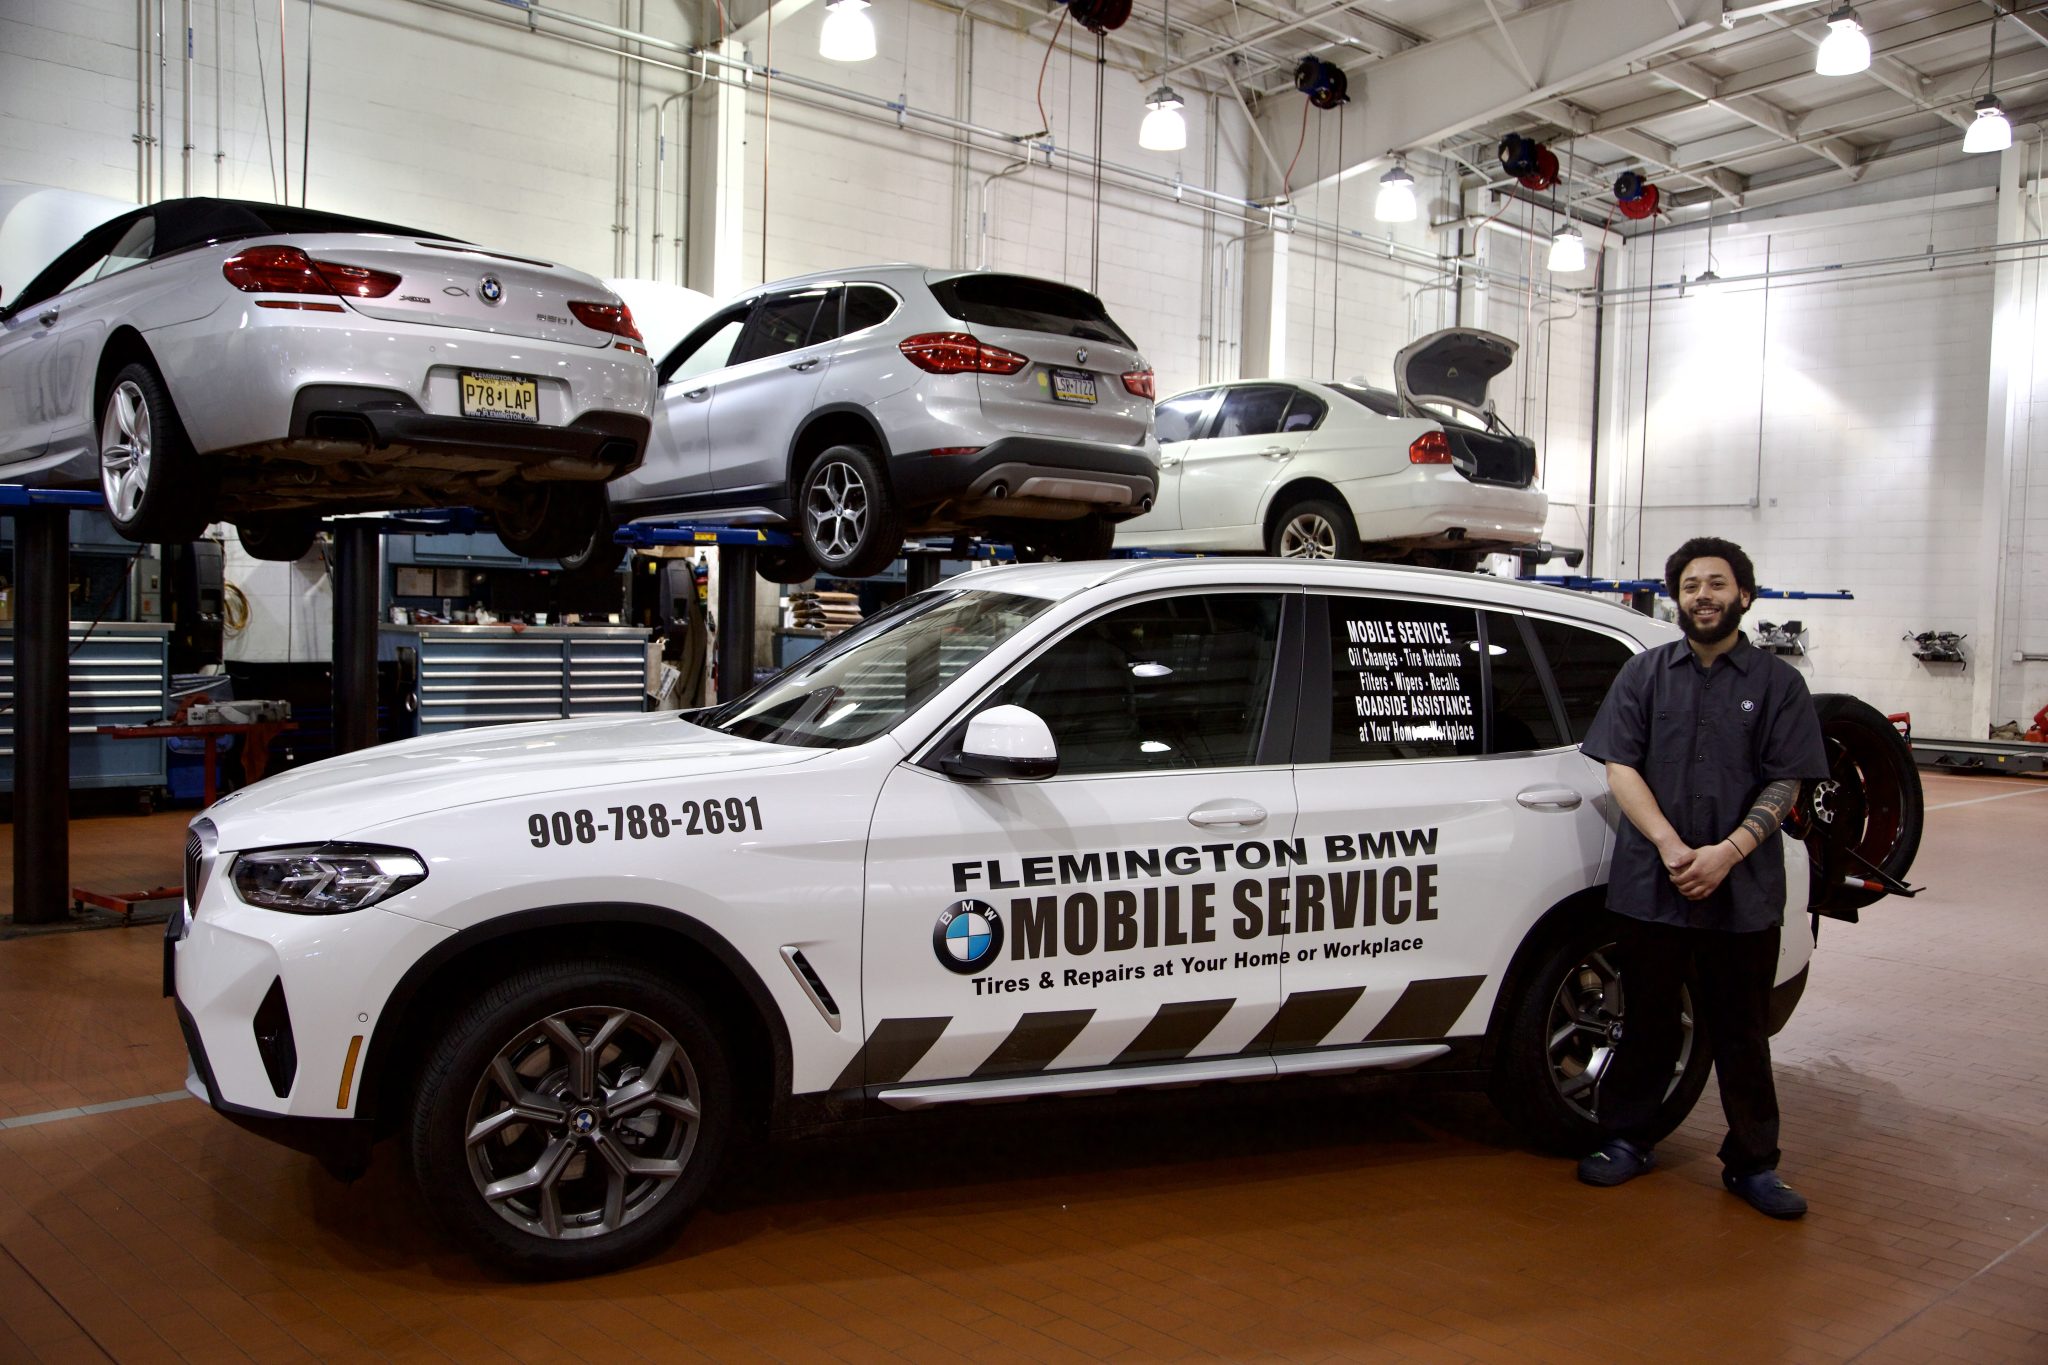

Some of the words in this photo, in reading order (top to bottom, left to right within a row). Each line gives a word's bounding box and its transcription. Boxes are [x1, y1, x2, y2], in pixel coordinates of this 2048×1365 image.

[466, 384, 494, 406] P78
[504, 388, 532, 410] LAP
[1346, 621, 1397, 643] MOBILE
[1397, 621, 1451, 644] SERVICE
[1348, 647, 1361, 667] Oil
[1362, 648, 1398, 671] Changes
[1403, 648, 1421, 667] Tire
[1422, 648, 1461, 667] Rotations
[1359, 672, 1389, 691] Filters
[1394, 672, 1424, 695] Wipers
[1429, 672, 1460, 691] Recalls
[1355, 696, 1409, 716] ROADSIDE
[1411, 696, 1473, 716] ASSISTANCE
[1359, 722, 1368, 742] at
[1369, 721, 1391, 741] Your
[528, 796, 763, 848] 908-788-2691
[952, 837, 1308, 893] FLEMINGTON
[1324, 828, 1439, 863] BMW
[1010, 882, 1216, 961] MOBILE
[1232, 863, 1439, 940] SERVICE
[971, 976, 1030, 996] Tires
[1038, 971, 1055, 989] &
[1063, 963, 1146, 988] Repairs
[1152, 959, 1174, 978] at
[1181, 956, 1228, 974] Your
[1234, 951, 1290, 968] Home
[1297, 947, 1317, 962] or
[1323, 937, 1424, 961] Workplace
